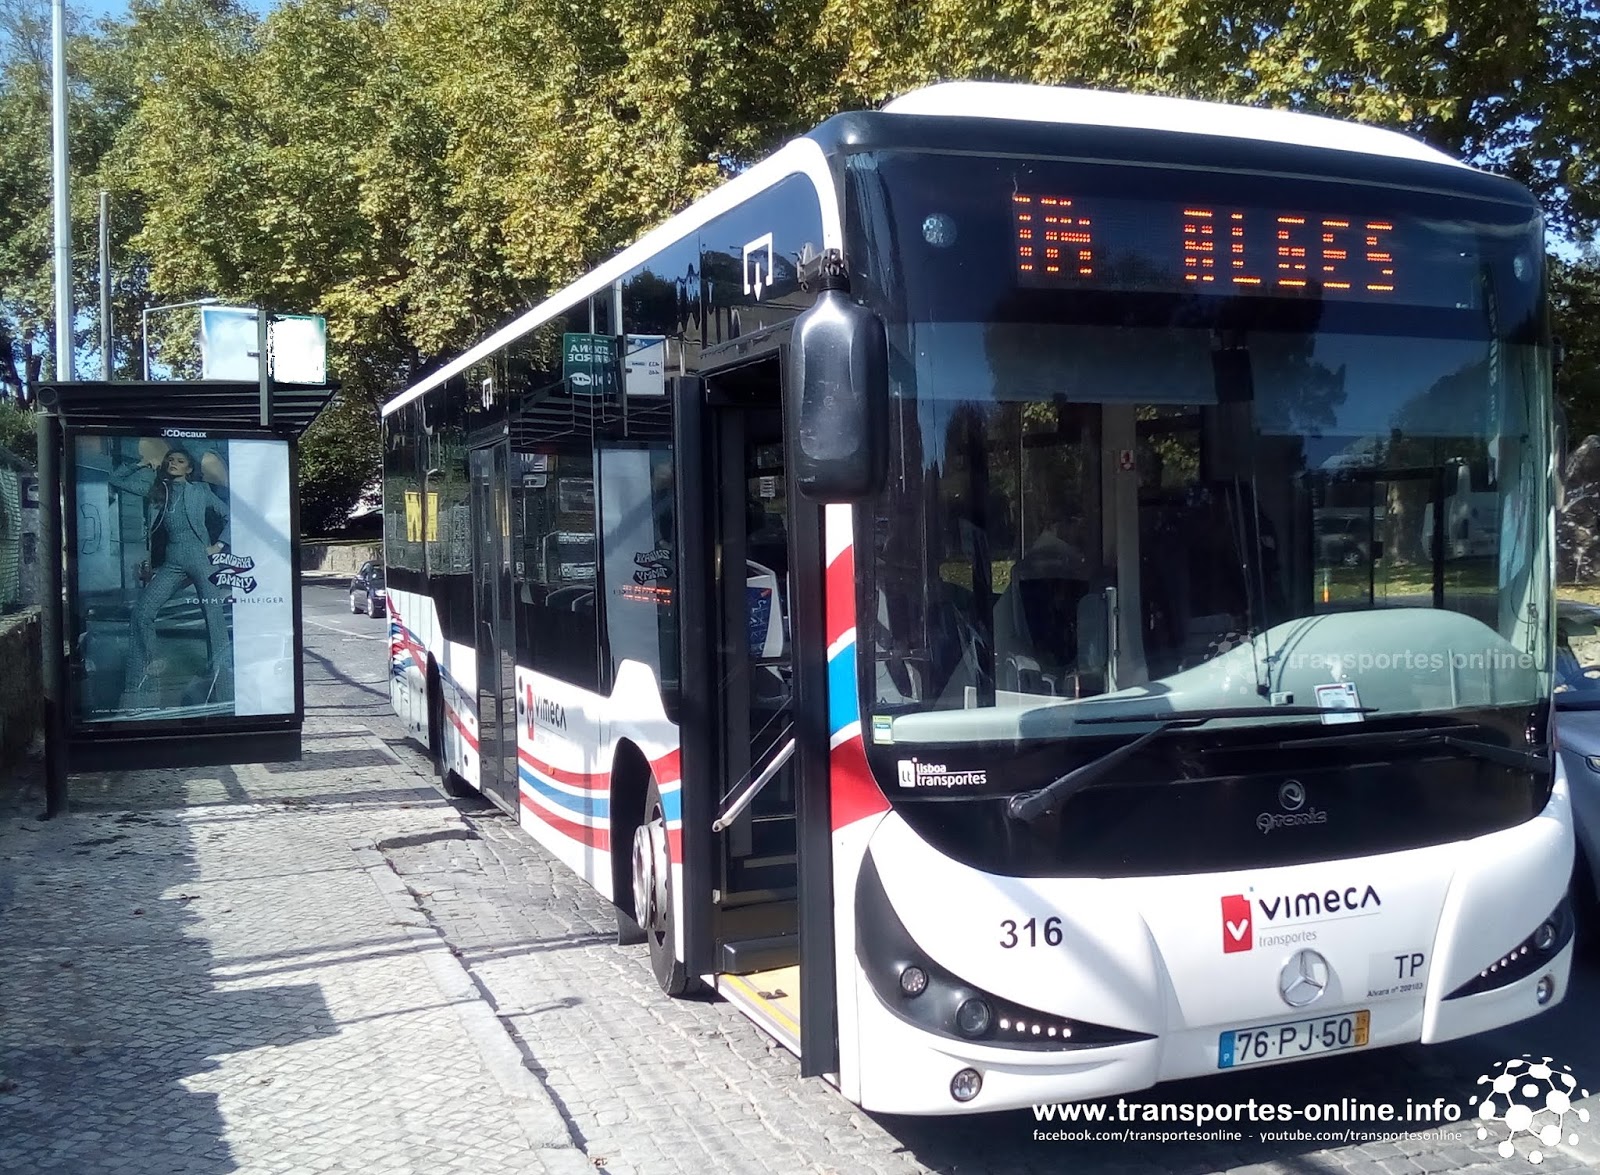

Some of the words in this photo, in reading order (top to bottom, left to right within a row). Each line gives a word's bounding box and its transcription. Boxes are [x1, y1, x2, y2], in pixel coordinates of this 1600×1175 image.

[1183, 208, 1395, 291] ALGES
[160, 429, 207, 438] JCDecaux
[211, 553, 251, 569] ZENDAYA
[216, 573, 254, 588] TOMMY
[916, 772, 987, 789] transportes
[999, 916, 1063, 949] 316
[1258, 930, 1318, 948] transportes
[1394, 953, 1425, 979] TP
